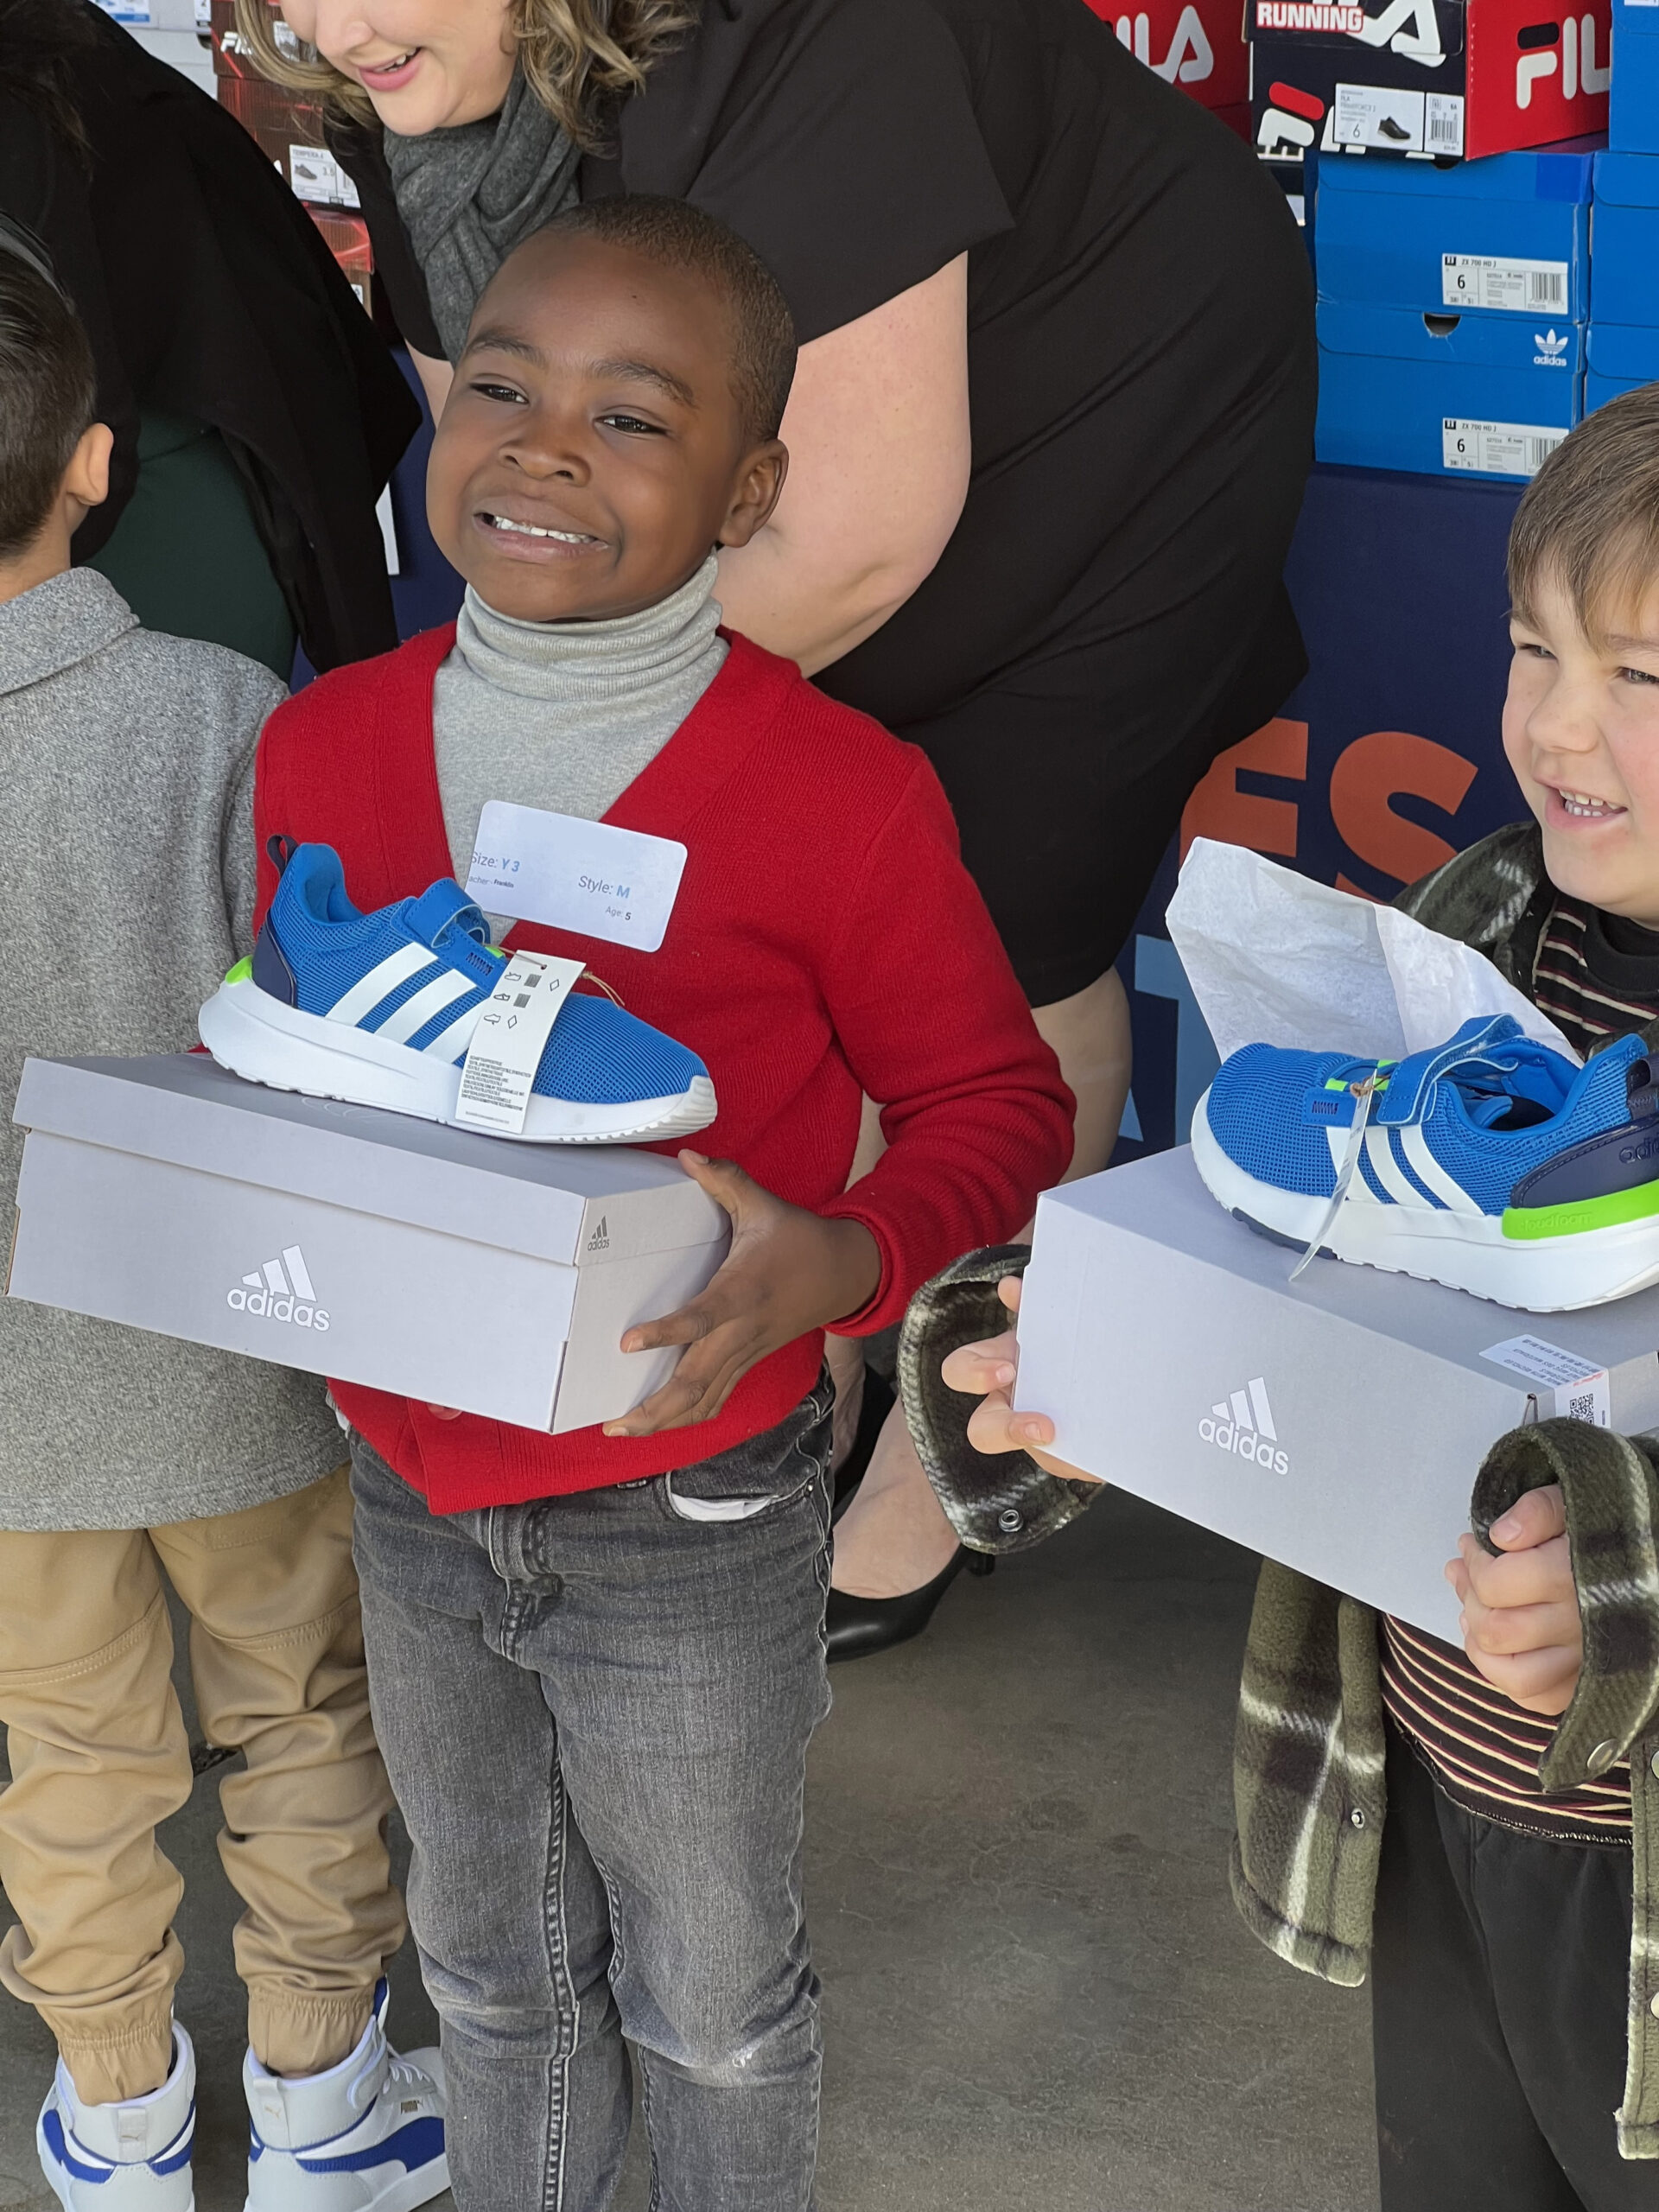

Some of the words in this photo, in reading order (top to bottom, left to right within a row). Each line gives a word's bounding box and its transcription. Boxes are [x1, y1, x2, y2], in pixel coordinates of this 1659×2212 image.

[1257, 3, 1363, 33] RUNNING
[1116, 4, 1214, 84] ILA
[1516, 14, 1611, 110] FIL
[1352, 124, 1361, 138] 6
[1457, 274, 1465, 289] 6
[1534, 355, 1567, 366] adidas
[1457, 438, 1465, 453] 6
[502, 858, 511, 870] Y
[511, 861, 520, 873] 3
[578, 875, 613, 895] Style:
[616, 885, 631, 899] M
[624, 912, 632, 921] 5
[587, 1237, 610, 1252] adidas
[226, 1288, 332, 1332] adidas
[1198, 1418, 1289, 1476] adidas
